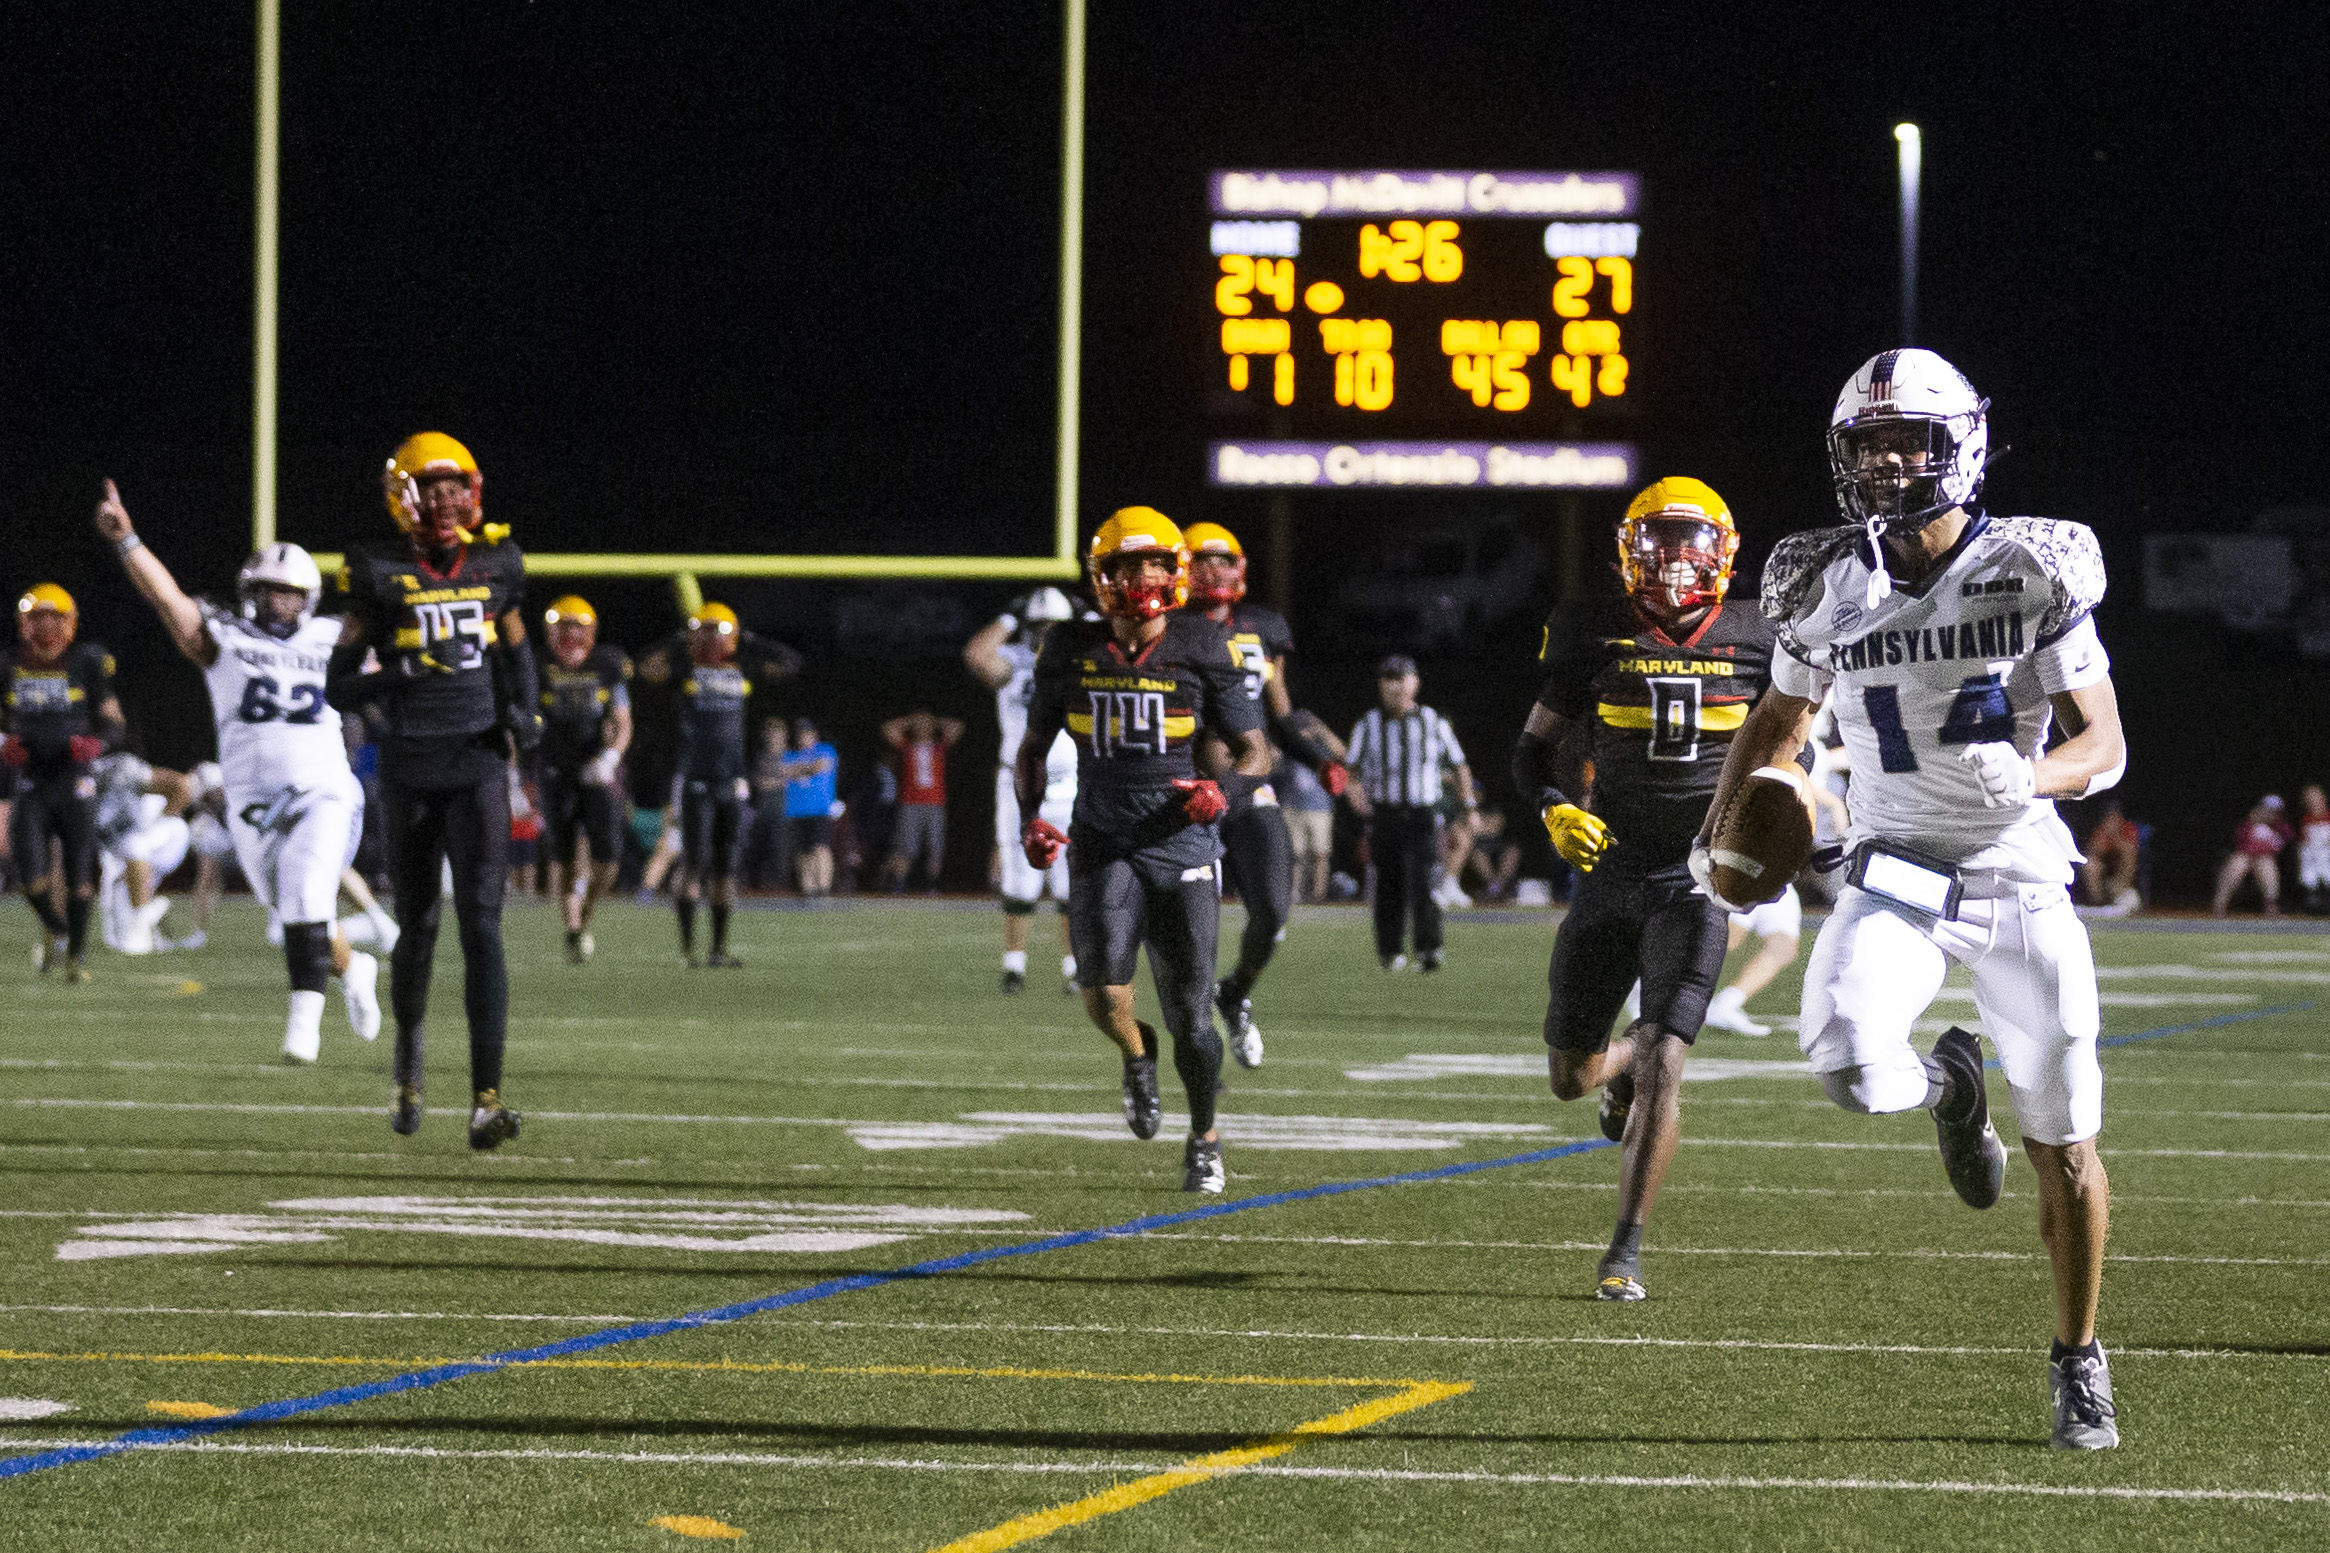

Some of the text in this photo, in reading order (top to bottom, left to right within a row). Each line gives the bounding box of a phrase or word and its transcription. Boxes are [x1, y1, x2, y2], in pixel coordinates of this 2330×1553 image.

[1215, 254, 1295, 316] 24
[1552, 256, 1632, 317] 27
[1335, 350, 1394, 411] 10
[1451, 351, 1530, 412] 45
[1551, 353, 1591, 408] 4
[1619, 659, 1734, 676] MARYLAND
[239, 676, 325, 724] 62
[1088, 691, 1167, 759] 14
[1863, 672, 2018, 773] 14
